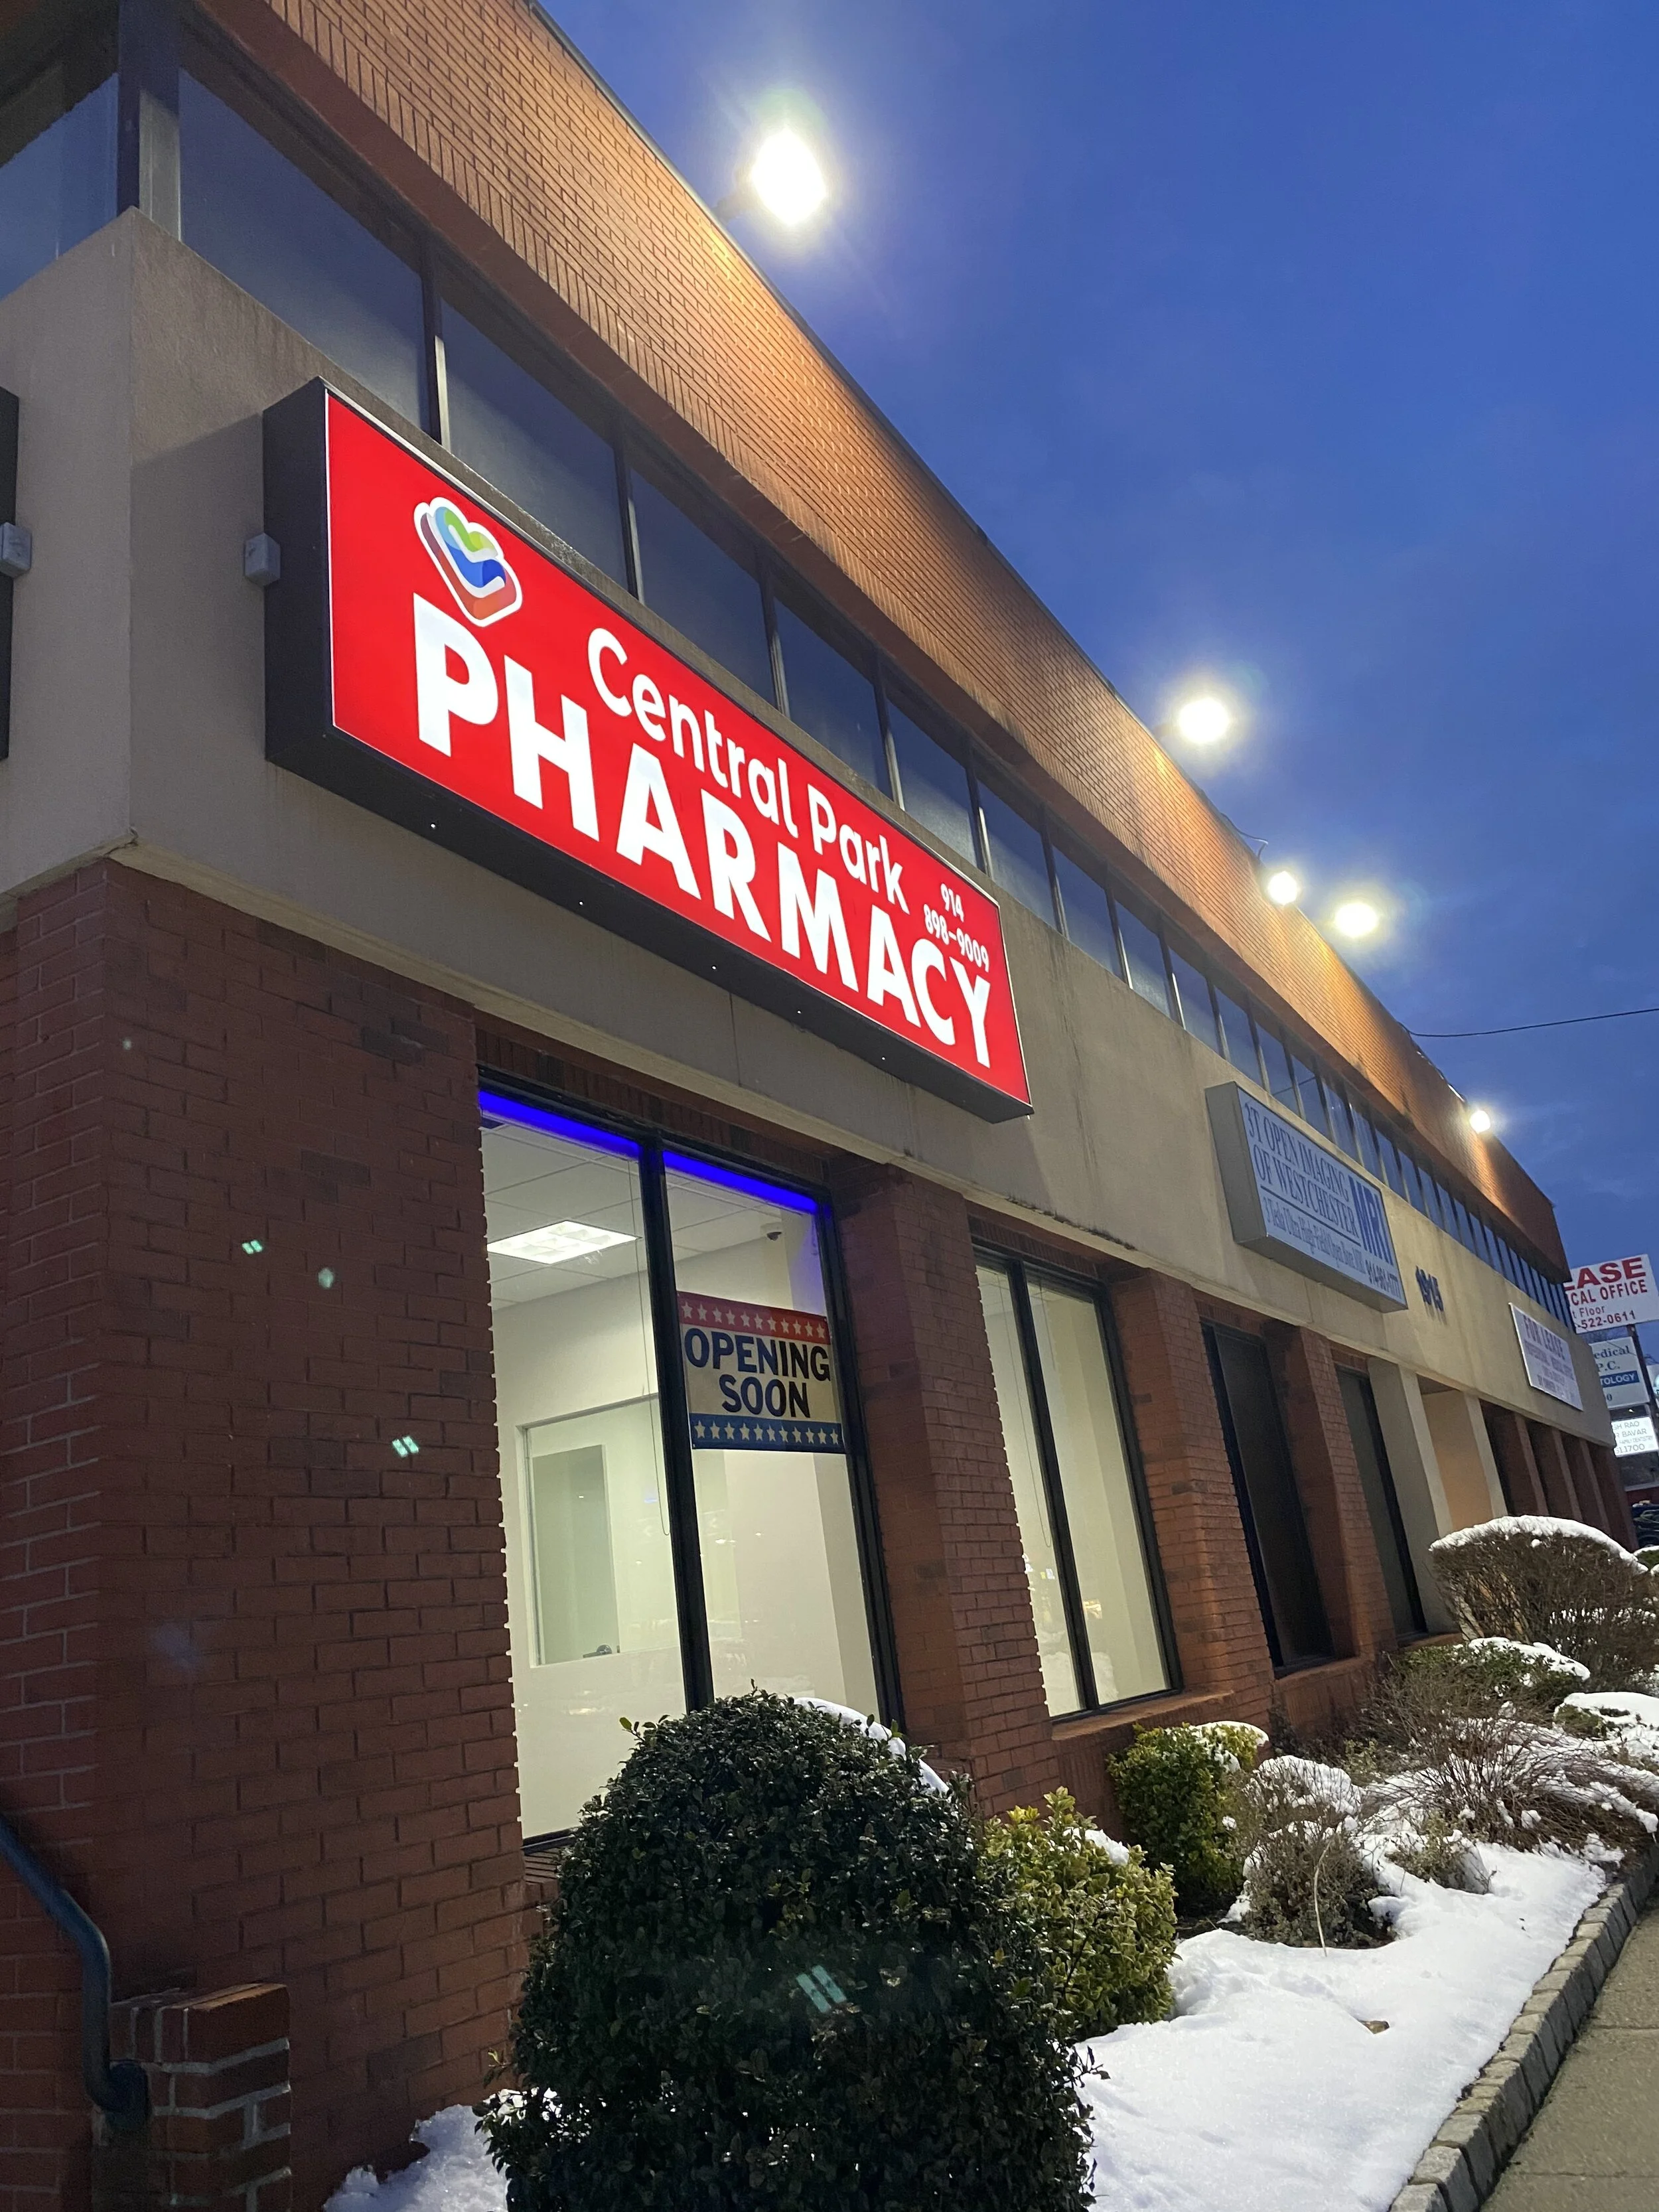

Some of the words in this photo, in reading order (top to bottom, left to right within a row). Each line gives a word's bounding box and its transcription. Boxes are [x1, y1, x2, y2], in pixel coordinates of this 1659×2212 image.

[588, 628, 798, 838] Central
[808, 784, 910, 915] Park
[413, 593, 990, 1067] PHARMACY
[940, 883, 964, 922] 914
[924, 904, 989, 972] 898-9009
[1243, 1100, 1265, 1146] 3T
[1261, 1113, 1301, 1171] OPEN
[1297, 1140, 1350, 1205] IMAGING
[1251, 1141, 1274, 1187] OF
[1272, 1155, 1360, 1240] WESTCHESTER
[1348, 1173, 1394, 1266] MRI
[1563, 1257, 1646, 1291] ASE
[1600, 1280, 1647, 1299] OFFICE
[1579, 1306, 1605, 1317] Floor
[684, 1328, 831, 1381] OPENING
[719, 1374, 811, 1418] SOON
[1621, 1428, 1647, 1438] BAVAR
